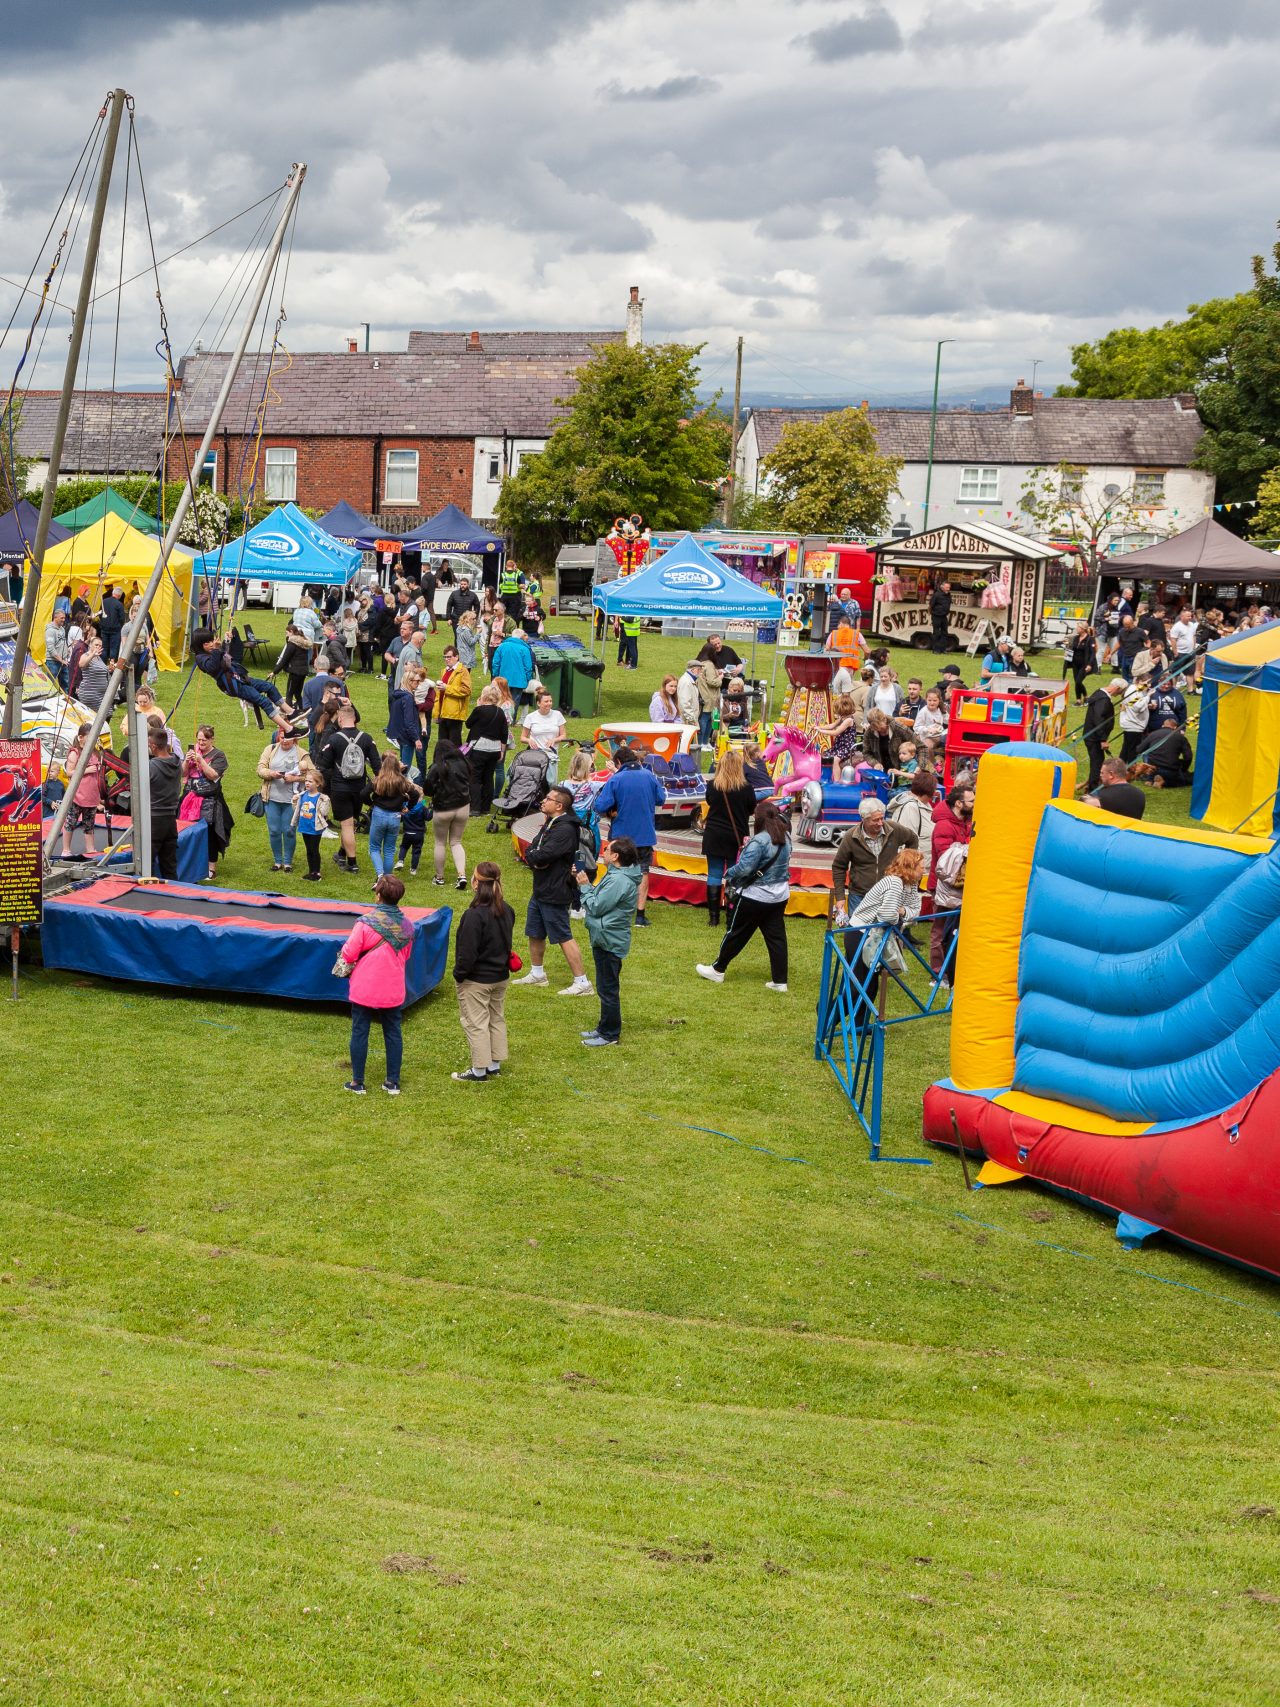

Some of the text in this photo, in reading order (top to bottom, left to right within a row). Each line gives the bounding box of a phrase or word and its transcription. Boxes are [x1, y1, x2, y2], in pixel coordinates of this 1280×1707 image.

[336, 538, 357, 546] TARY
[420, 542, 470, 551] HYDE ROTARY
[904, 532, 990, 553] CANDY CABIN
[378, 543, 400, 552] BAR
[621, 602, 768, 612] www.sportstoursinternational.co.uk
[1021, 564, 1034, 640] DOUGHNUTS
[882, 608, 930, 634] SWEE
